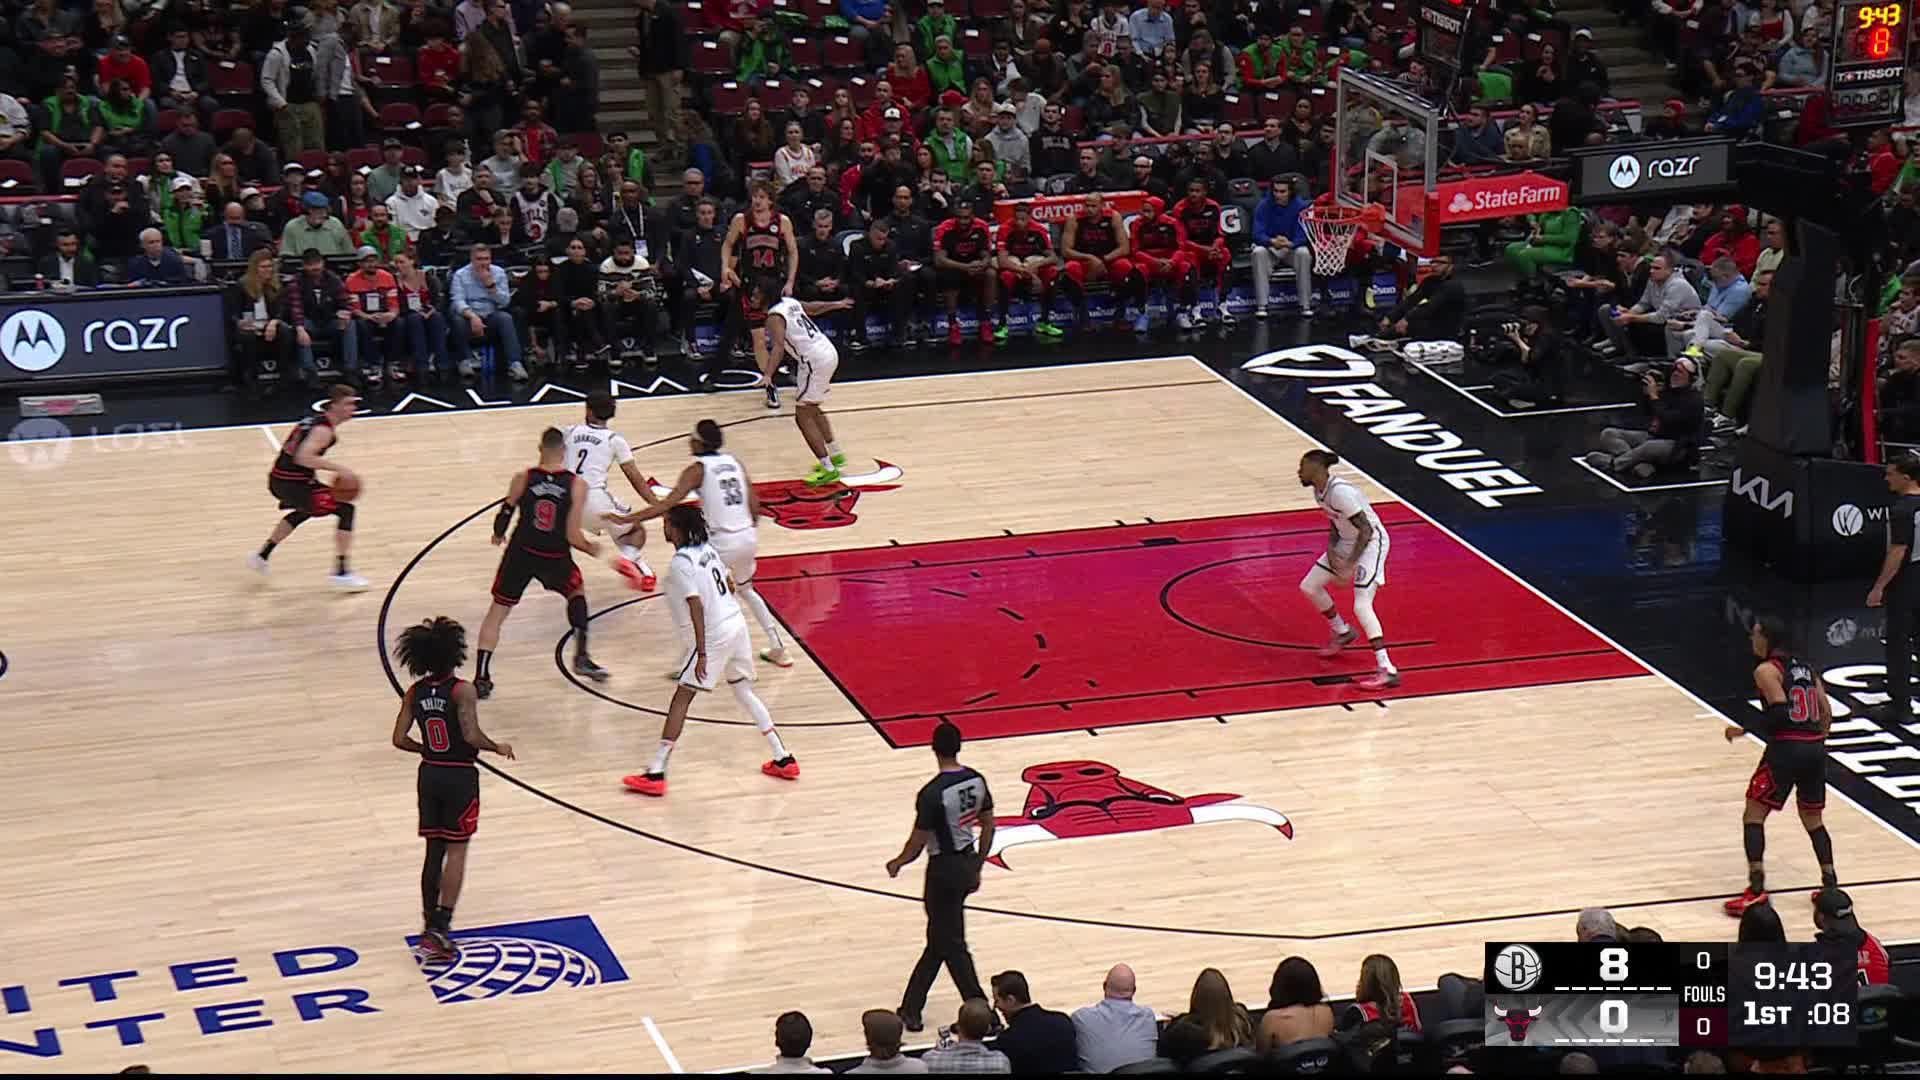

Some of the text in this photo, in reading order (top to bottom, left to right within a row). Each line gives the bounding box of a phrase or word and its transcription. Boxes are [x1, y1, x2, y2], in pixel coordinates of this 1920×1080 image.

[1859, 3, 1900, 28] 9:43
[1873, 27, 1890, 55] 8
[1856, 67, 1903, 81] TISSOT
[1648, 156, 1700, 178] razr
[83, 316, 190, 353] razr
[1306, 382, 1545, 508] FANDUEL
[575, 448, 588, 475] 2
[534, 499, 557, 531] 9
[711, 567, 726, 596] 8
[1788, 686, 1820, 722] 31
[425, 717, 450, 752] 0
